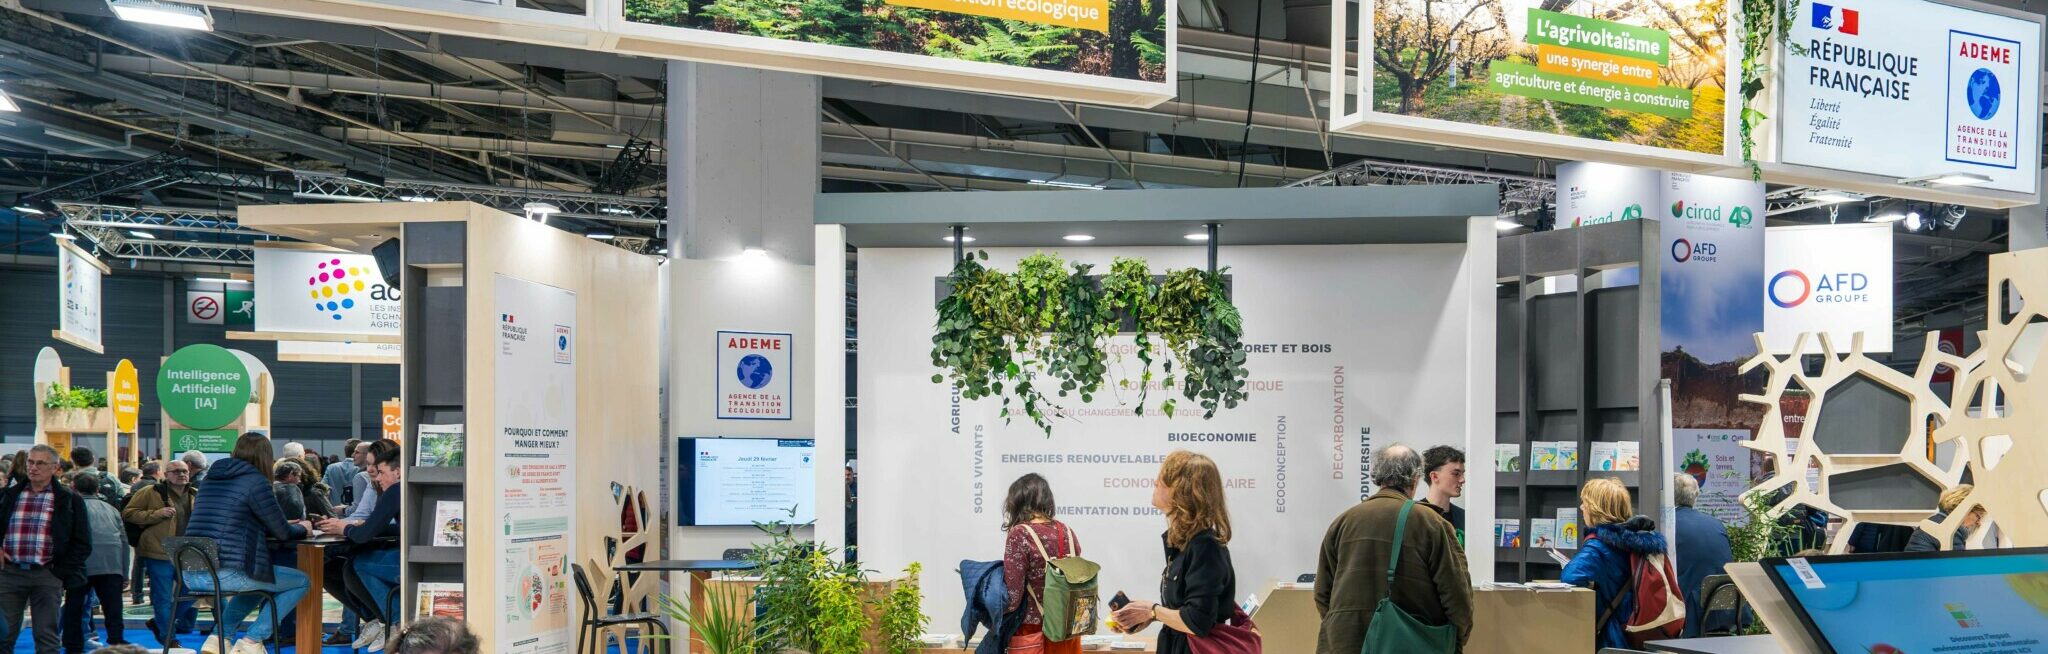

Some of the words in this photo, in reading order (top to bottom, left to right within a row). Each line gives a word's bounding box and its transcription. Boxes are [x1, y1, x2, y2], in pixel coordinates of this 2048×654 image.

[1537, 18, 1661, 56] L'agrivoltaïsme
[1810, 37, 1918, 77] RÉPUBLIQUE
[1959, 41, 2011, 64] ADEME
[1546, 52, 1569, 66] une
[1571, 57, 1619, 75] synergie
[1621, 64, 1653, 79] entre
[1810, 65, 1910, 101] FRANÇAISE
[1495, 71, 1561, 92] agriculture
[1563, 82, 1577, 94] et
[1579, 81, 1621, 102] énergie
[1623, 87, 1631, 101] à
[1633, 91, 1690, 110] construire
[1809, 98, 1841, 113] Liberté
[1809, 113, 1842, 130] Égalité
[1957, 125, 1988, 136] AGENCE
[1988, 128, 1997, 137] DE
[1999, 130, 2008, 138] LA
[1809, 132, 1853, 149] Fraternité
[1957, 135, 2008, 148] TRANSITION
[1686, 202, 1721, 221] cirad
[1693, 243, 1717, 255] AFD
[1816, 273, 1868, 292] AFD
[1815, 294, 1868, 303] GROUPE
[728, 337, 782, 350] ADEME
[1244, 343, 1278, 353] ORET
[1281, 344, 1298, 353] ET
[1301, 343, 1332, 354] BOIS
[167, 369, 240, 382] Intelligence
[171, 383, 237, 394] Artificielle
[195, 398, 217, 409] [IA]
[1077, 408, 1138, 417] CHANGEMEN
[1145, 408, 1201, 417] CLIMTIQUE
[1783, 414, 1806, 423] entre
[1333, 365, 1345, 480] DECARBONATION
[504, 427, 534, 437] POURQUOI
[534, 429, 541, 437] ET
[541, 429, 569, 437] COMMENT
[1168, 432, 1257, 442] BIOECONOMIE
[514, 440, 539, 448] MANGER
[539, 440, 556, 448] MIEUX
[974, 424, 983, 479] VIVANTS
[1001, 454, 1064, 463] ENERGIES
[1067, 454, 1167, 464] RENOUVELABLE
[1276, 415, 1286, 514] ECOCONCEPTION
[1360, 426, 1371, 503] ODIVERSITE
[1225, 478, 1256, 489] AIRE
[974, 481, 983, 514] SOLS
[1056, 506, 1129, 516] MENTATION
